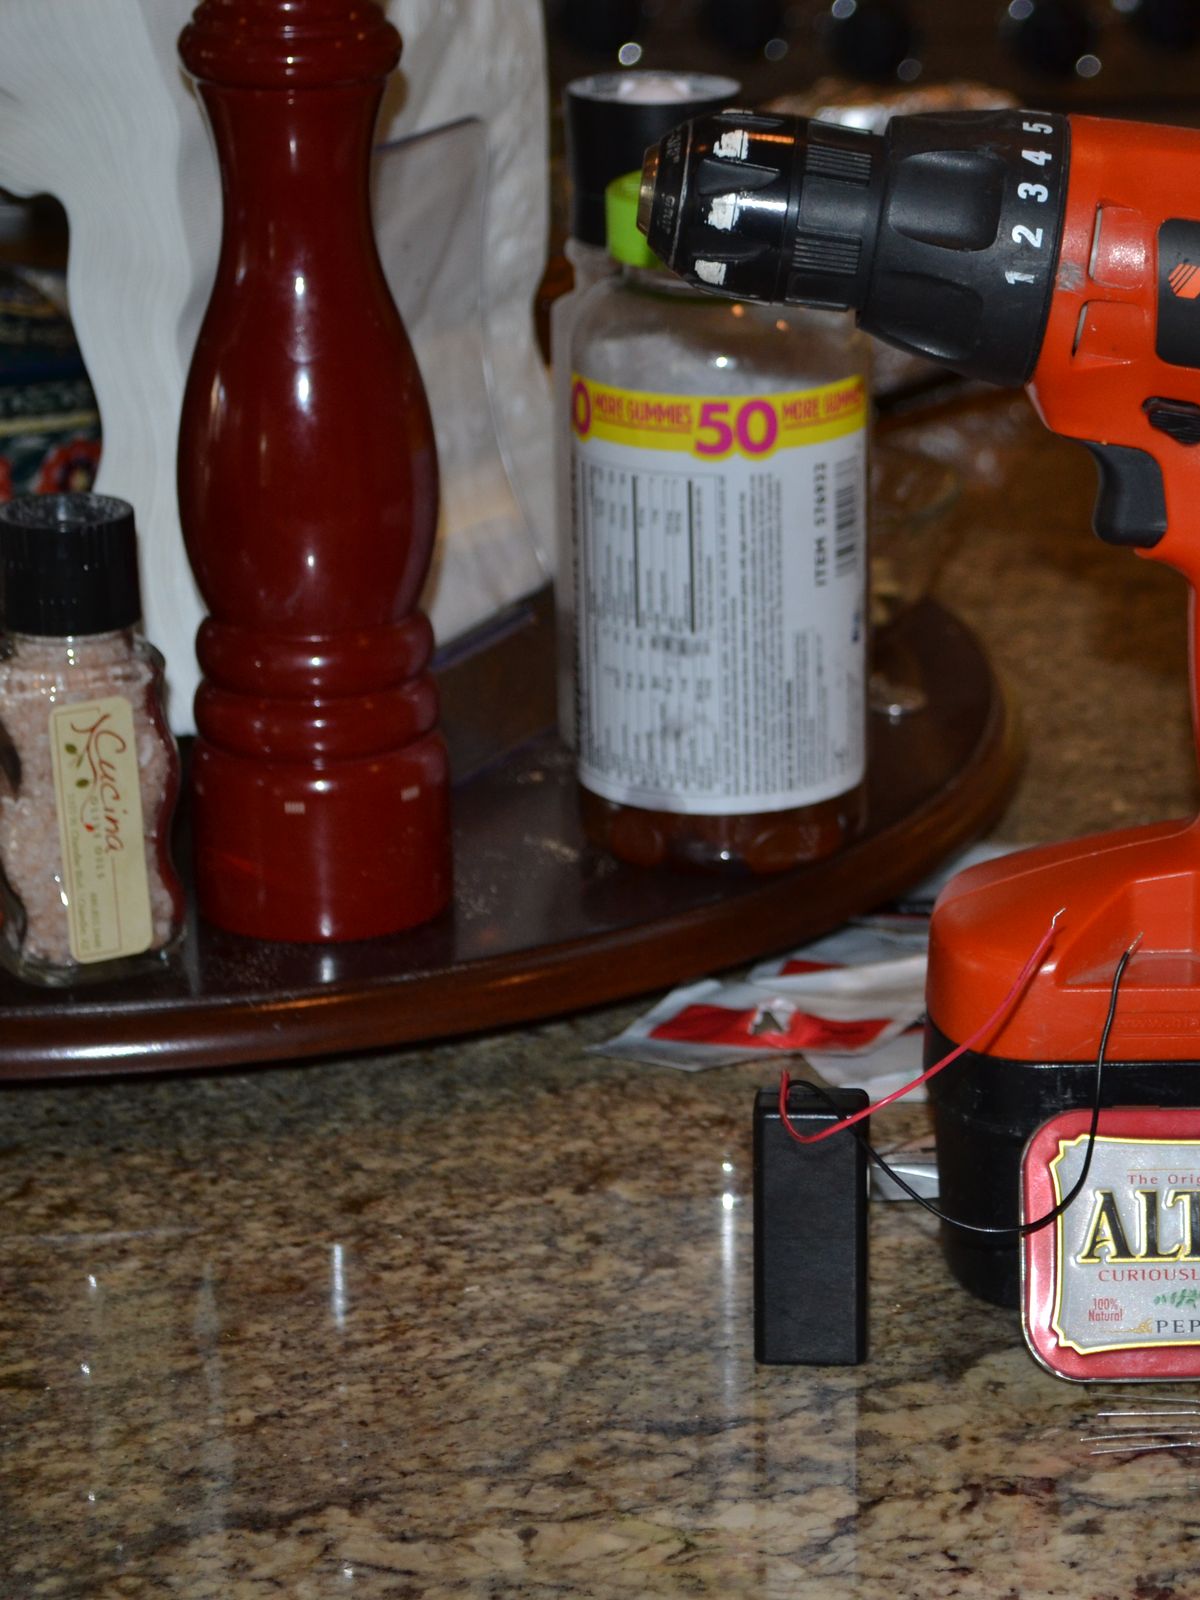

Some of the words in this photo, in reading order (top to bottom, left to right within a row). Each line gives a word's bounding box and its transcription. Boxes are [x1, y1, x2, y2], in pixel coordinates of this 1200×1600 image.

[1022, 121, 1053, 135] 5
[1021, 149, 1052, 166] 4
[1017, 182, 1049, 203] 3
[1011, 224, 1043, 248] 2
[1004, 270, 1035, 285] 1
[695, 400, 778, 455] 50
[94, 728, 128, 853] Cucina
[1127, 1174, 1158, 1185] The
[1092, 1297, 1119, 1311] 100%
[1088, 1308, 1123, 1322] Natural
